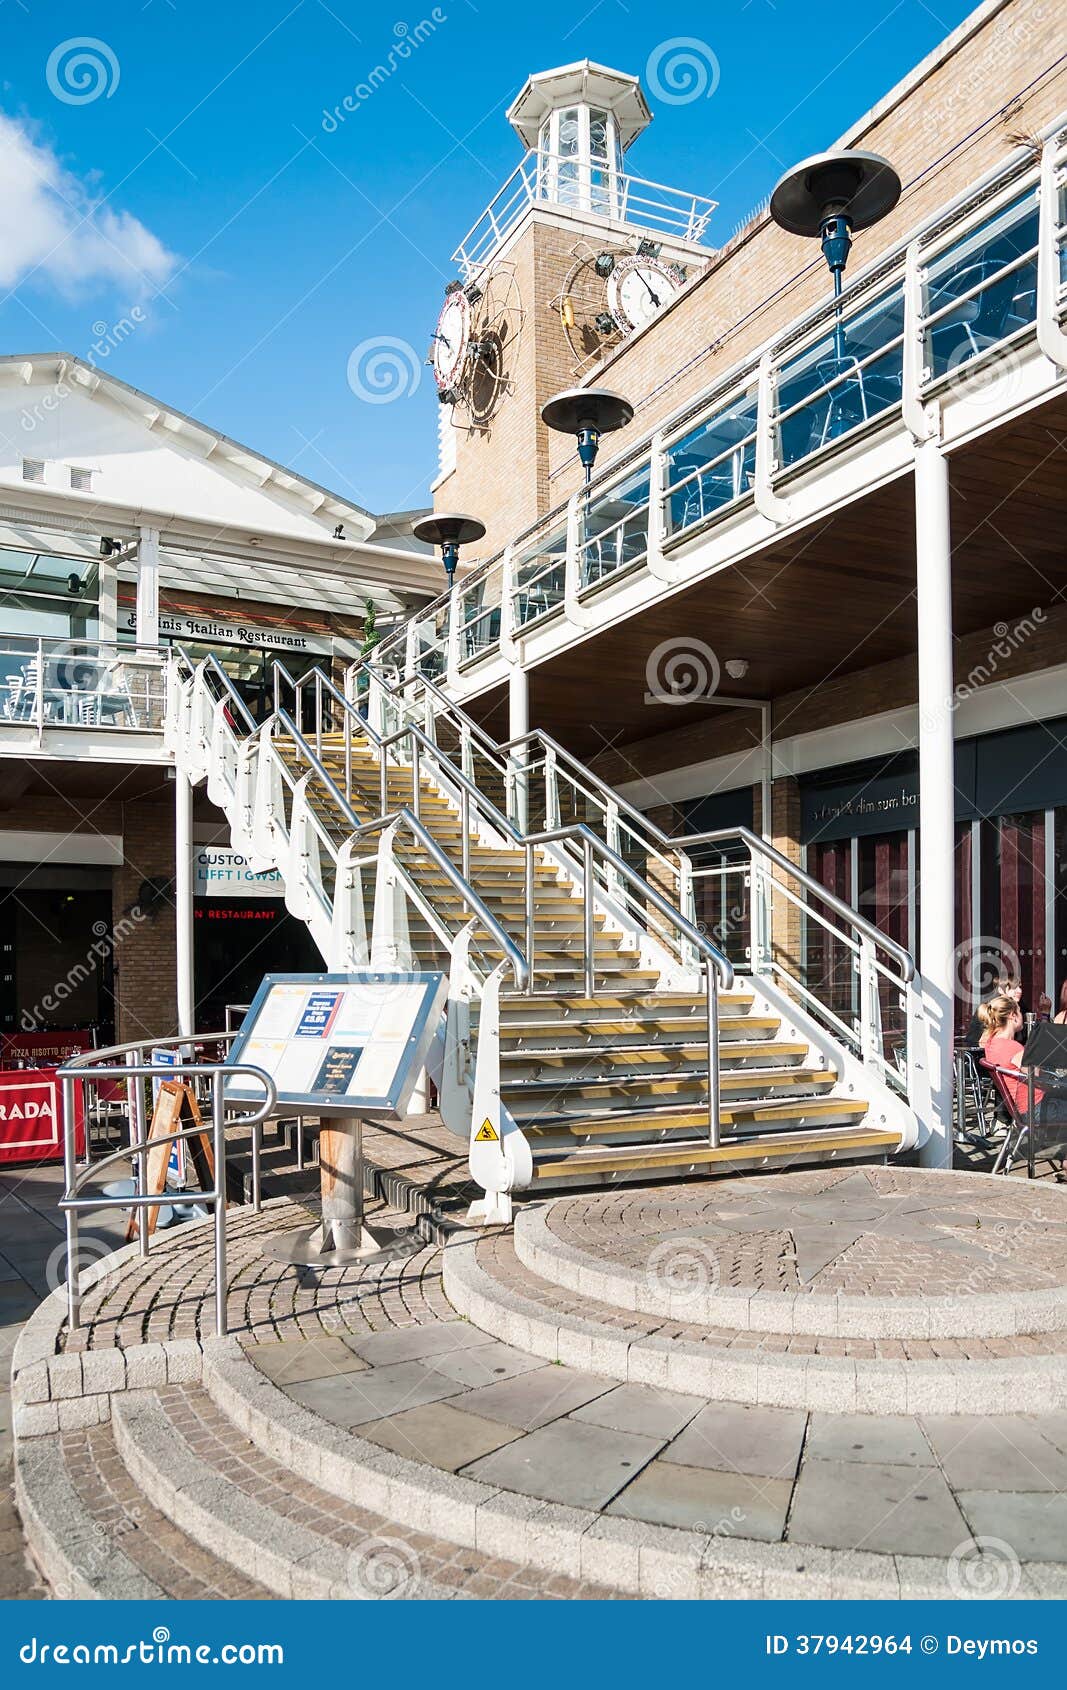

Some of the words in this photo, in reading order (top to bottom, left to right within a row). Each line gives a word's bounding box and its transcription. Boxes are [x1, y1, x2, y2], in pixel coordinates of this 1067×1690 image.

[187, 620, 233, 637] Italian
[237, 628, 307, 648] Restaurant
[198, 869, 233, 881] LIFFT
[208, 909, 275, 919] RESTAURANT
[10, 1048, 29, 1057] PIZZA
